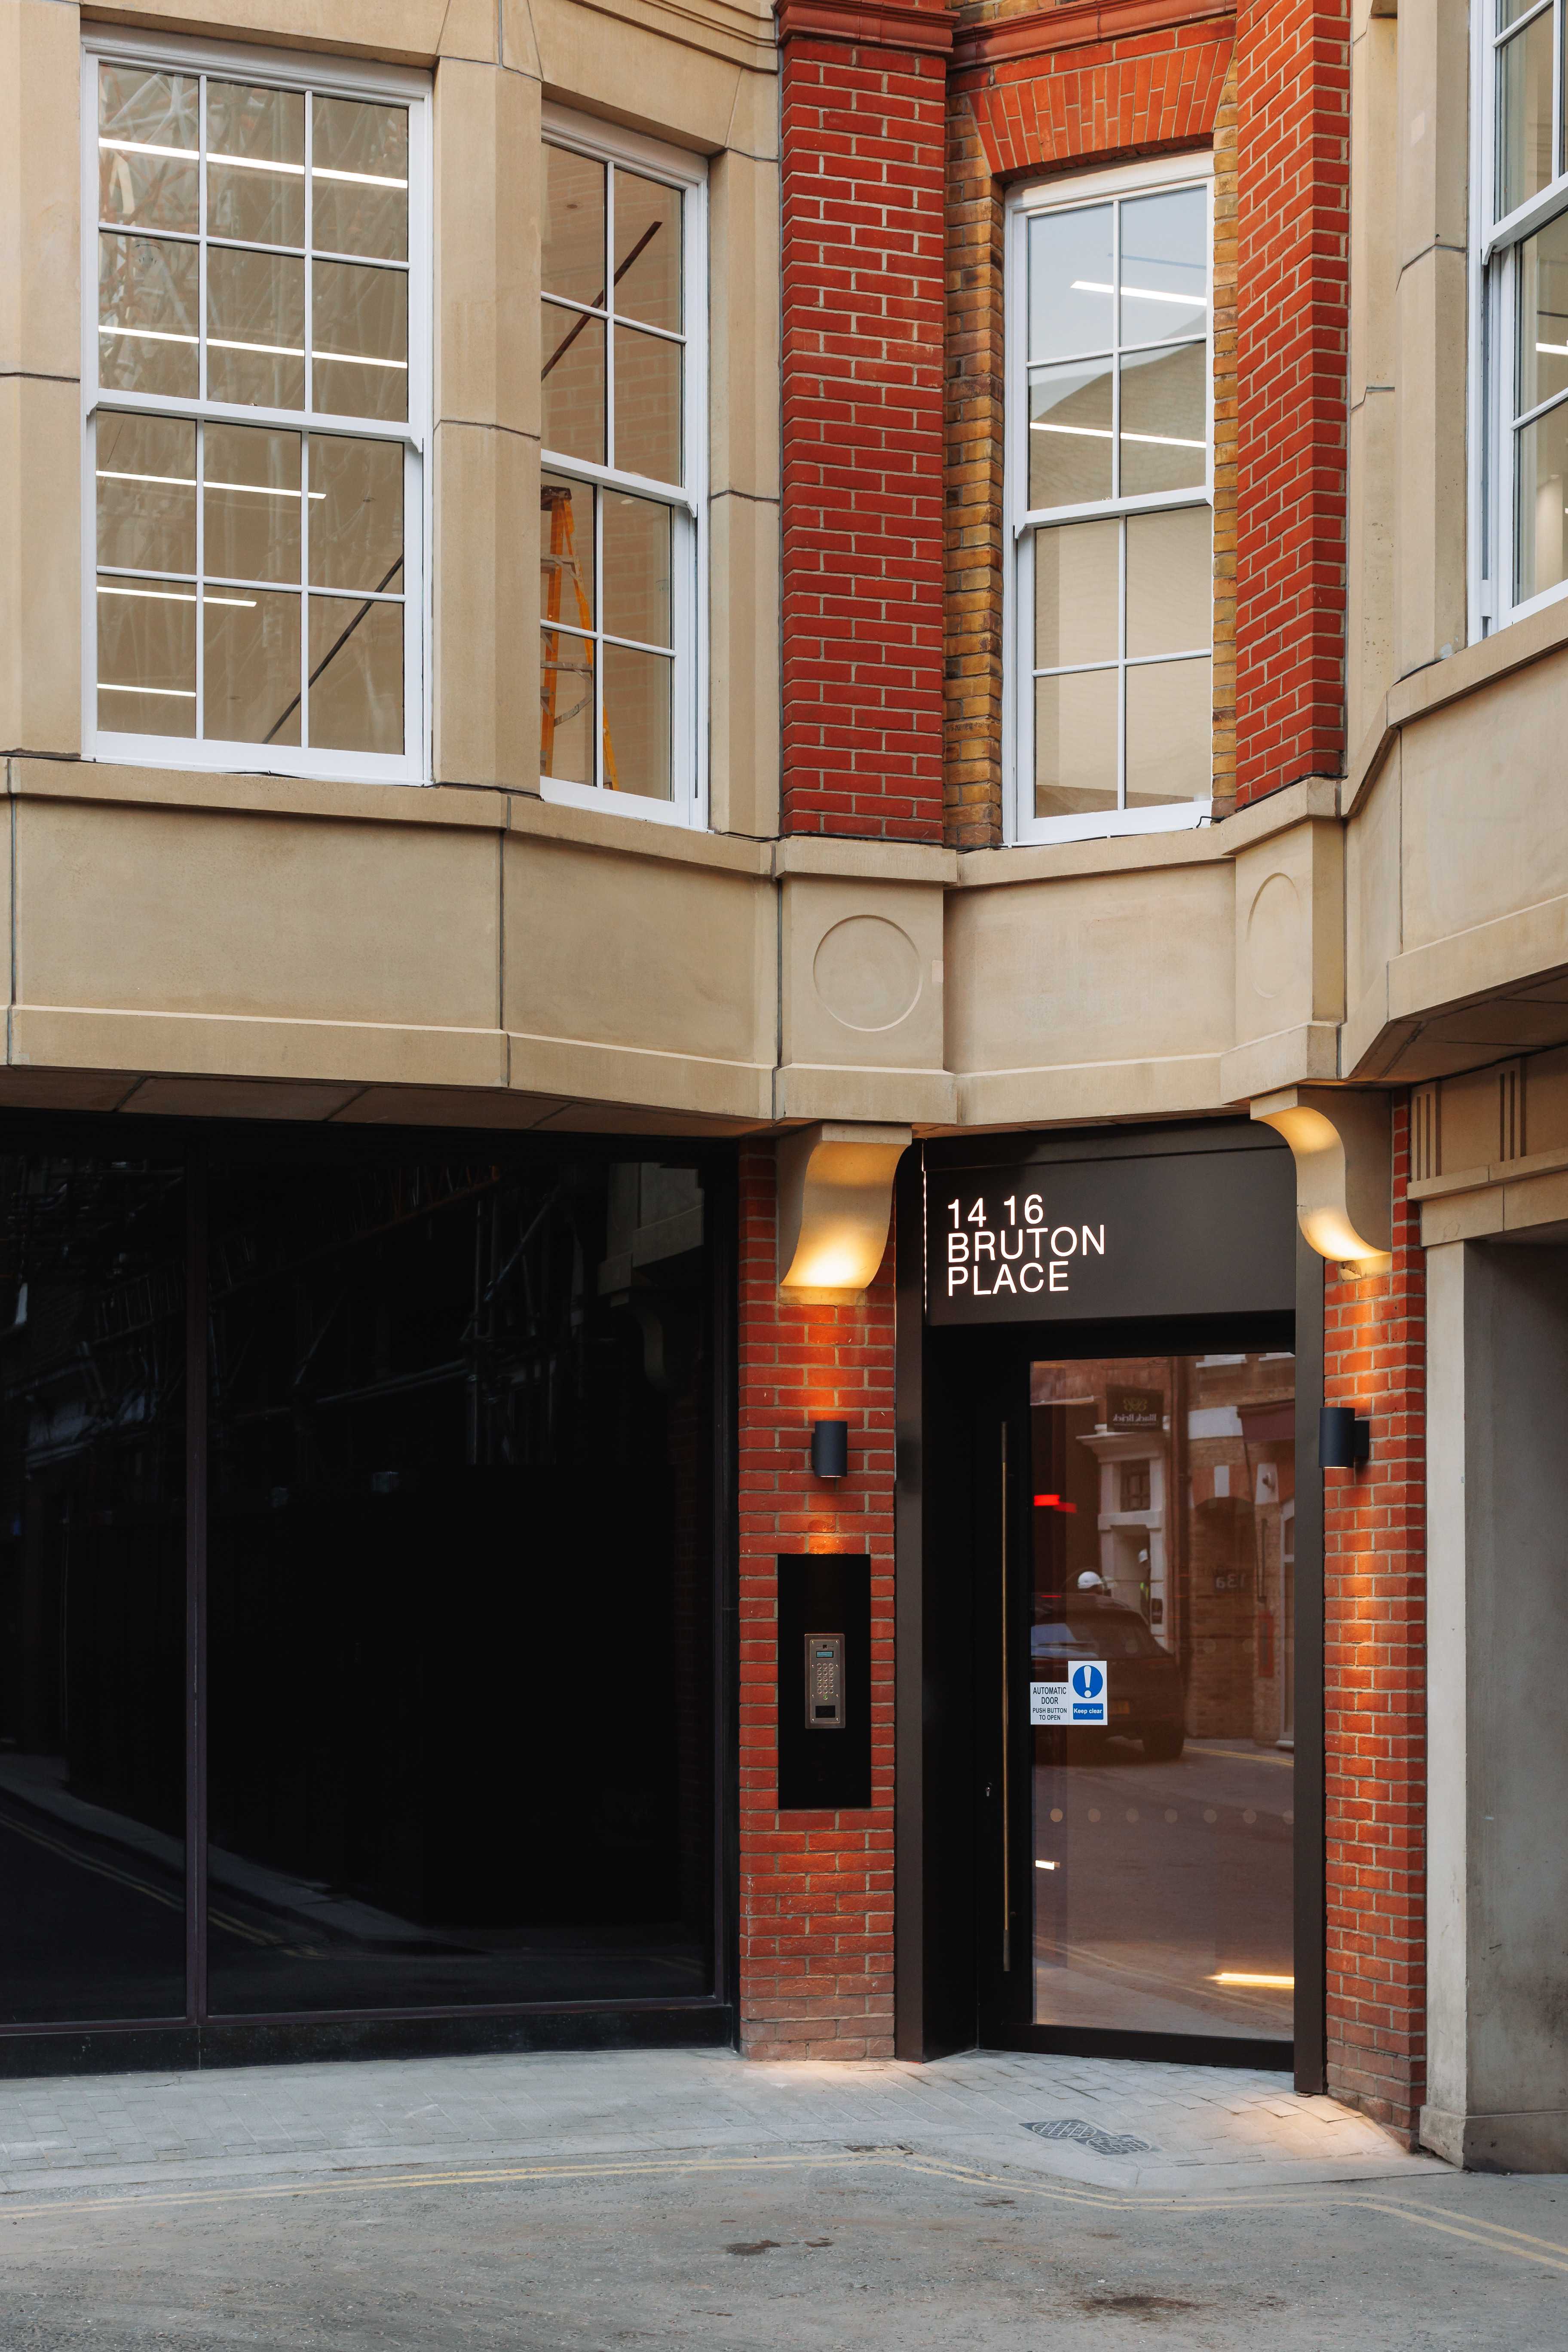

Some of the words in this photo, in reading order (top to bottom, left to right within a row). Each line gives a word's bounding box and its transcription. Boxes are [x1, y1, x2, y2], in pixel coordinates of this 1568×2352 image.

[947, 1197, 986, 1229] 14
[1004, 1194, 1044, 1225] 16
[948, 1224, 1105, 1263] BRUTON
[948, 1261, 1069, 1296] PLACE
